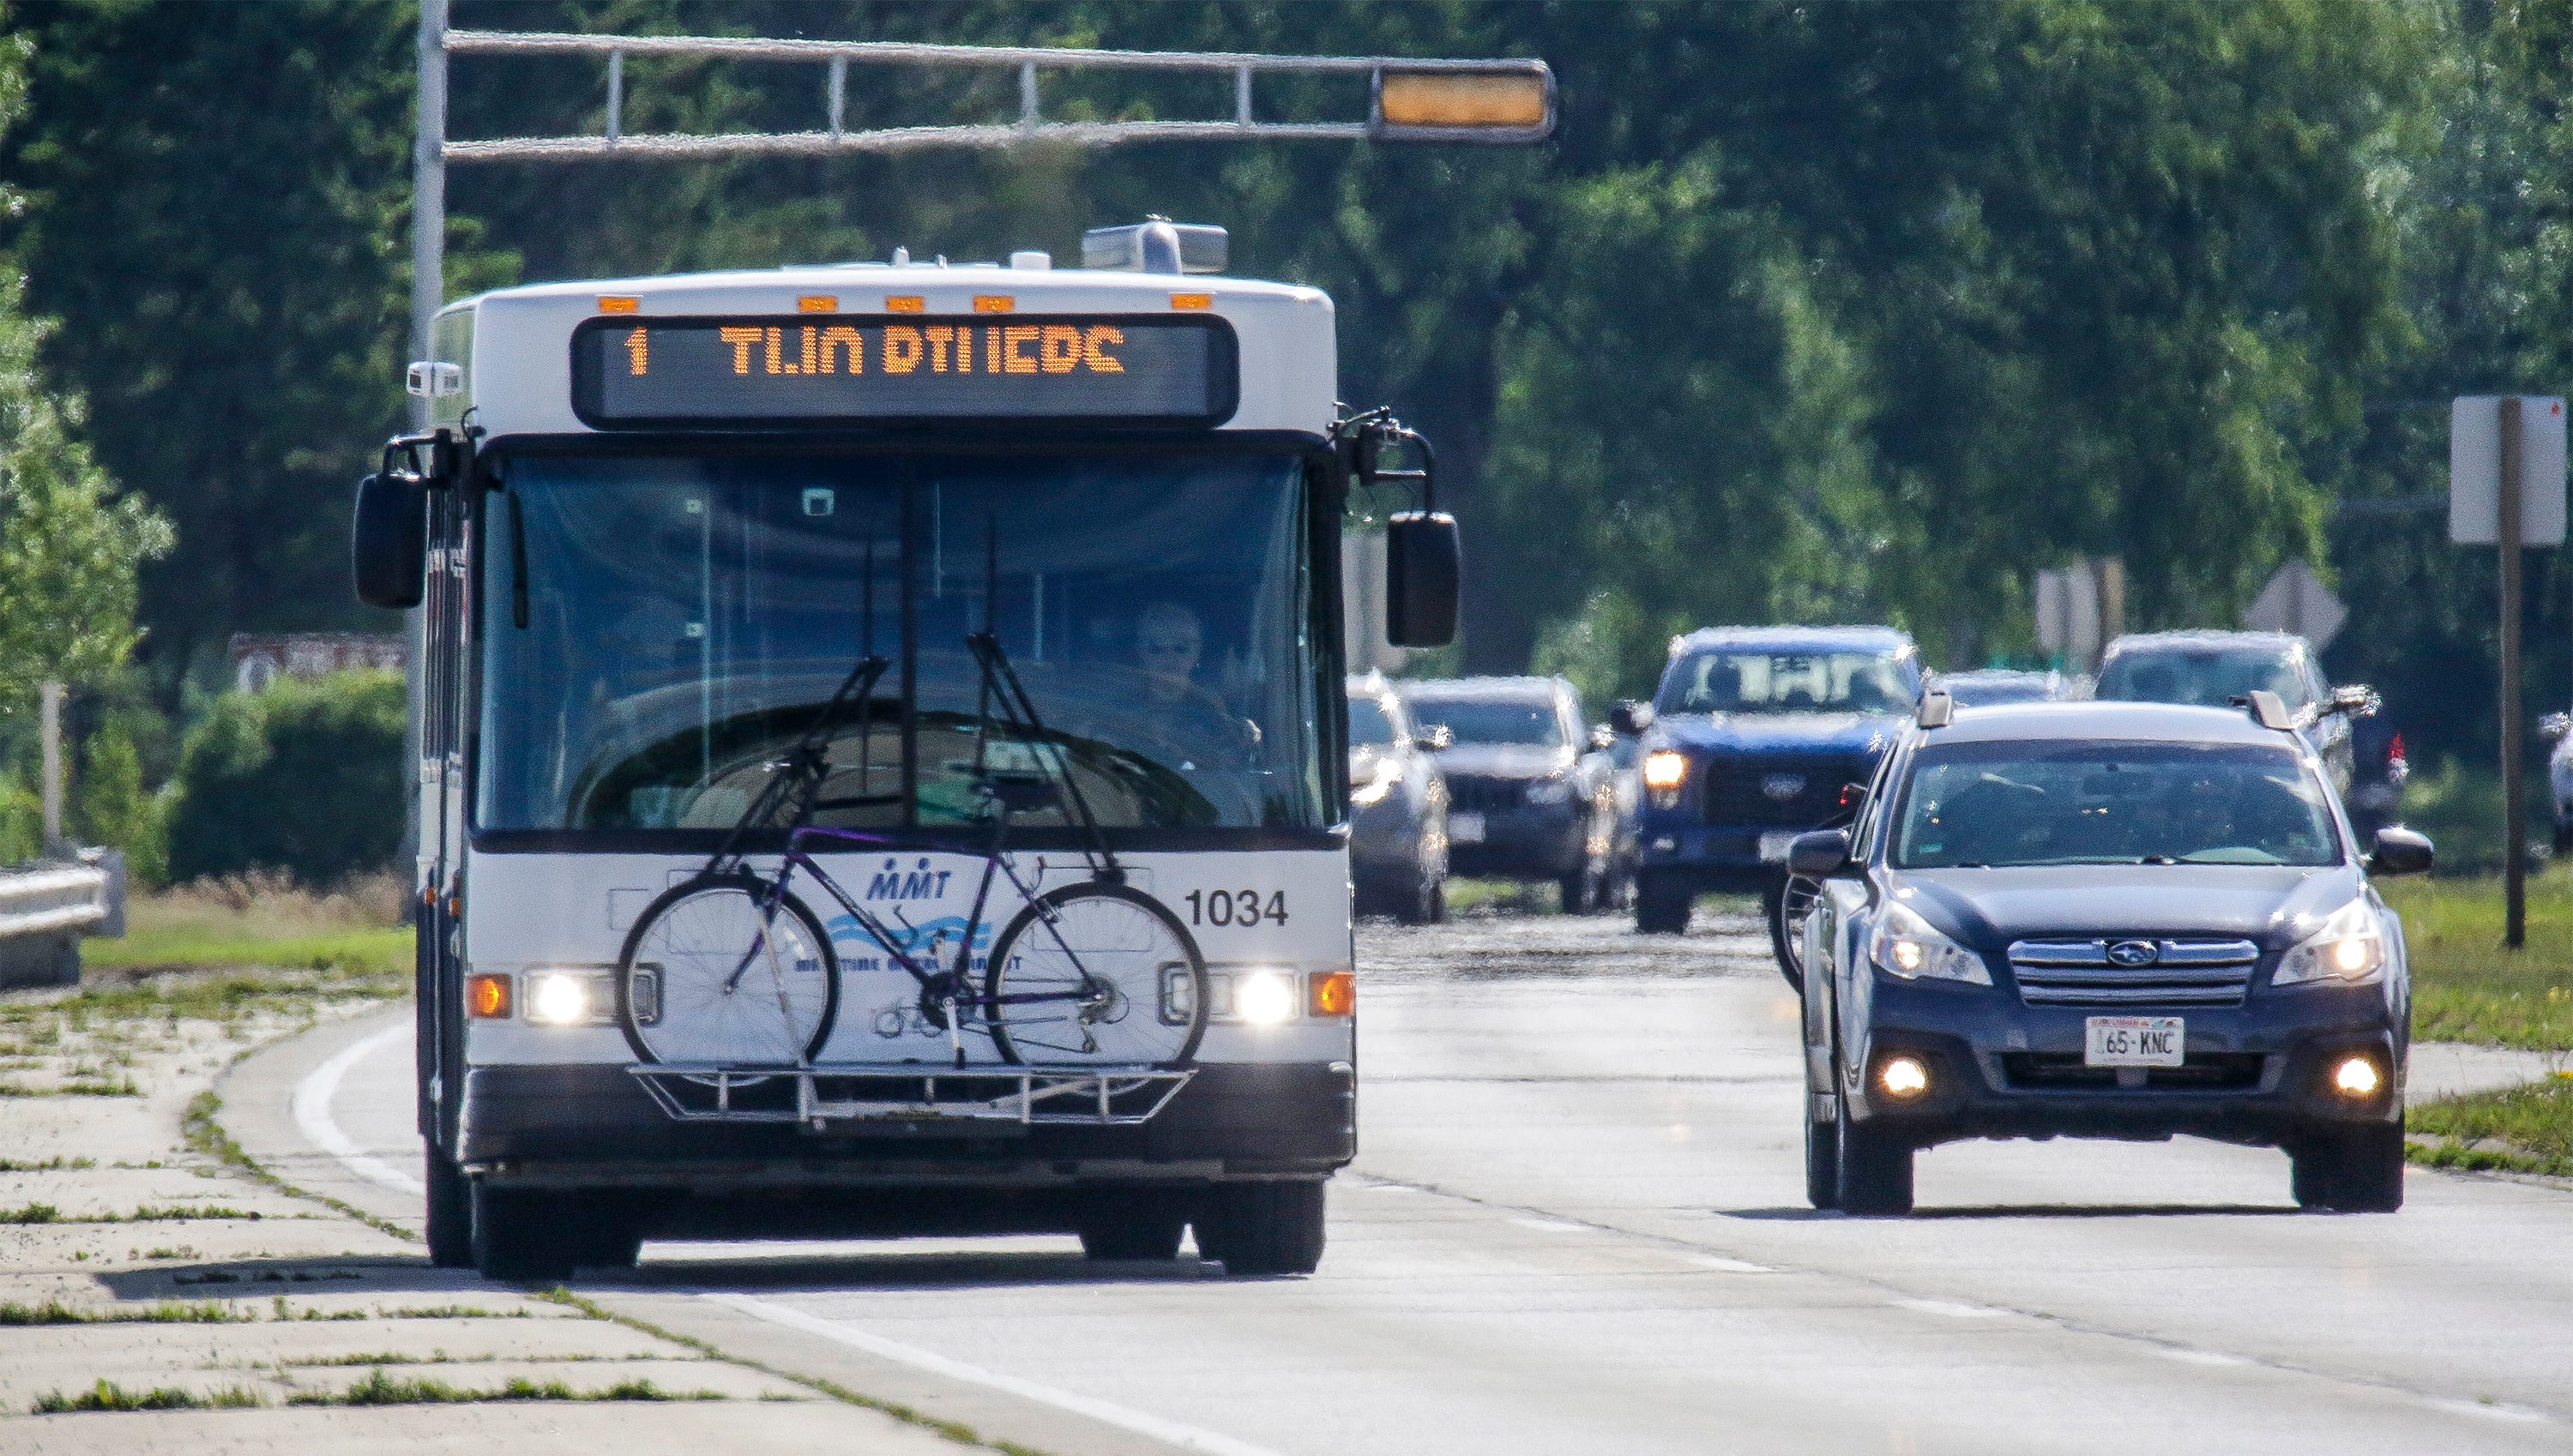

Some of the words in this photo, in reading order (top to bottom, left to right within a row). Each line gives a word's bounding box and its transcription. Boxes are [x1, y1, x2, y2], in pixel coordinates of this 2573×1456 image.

[624, 326, 648, 375] 1
[865, 869, 950, 899] MMT
[1185, 889, 1288, 927] 1034
